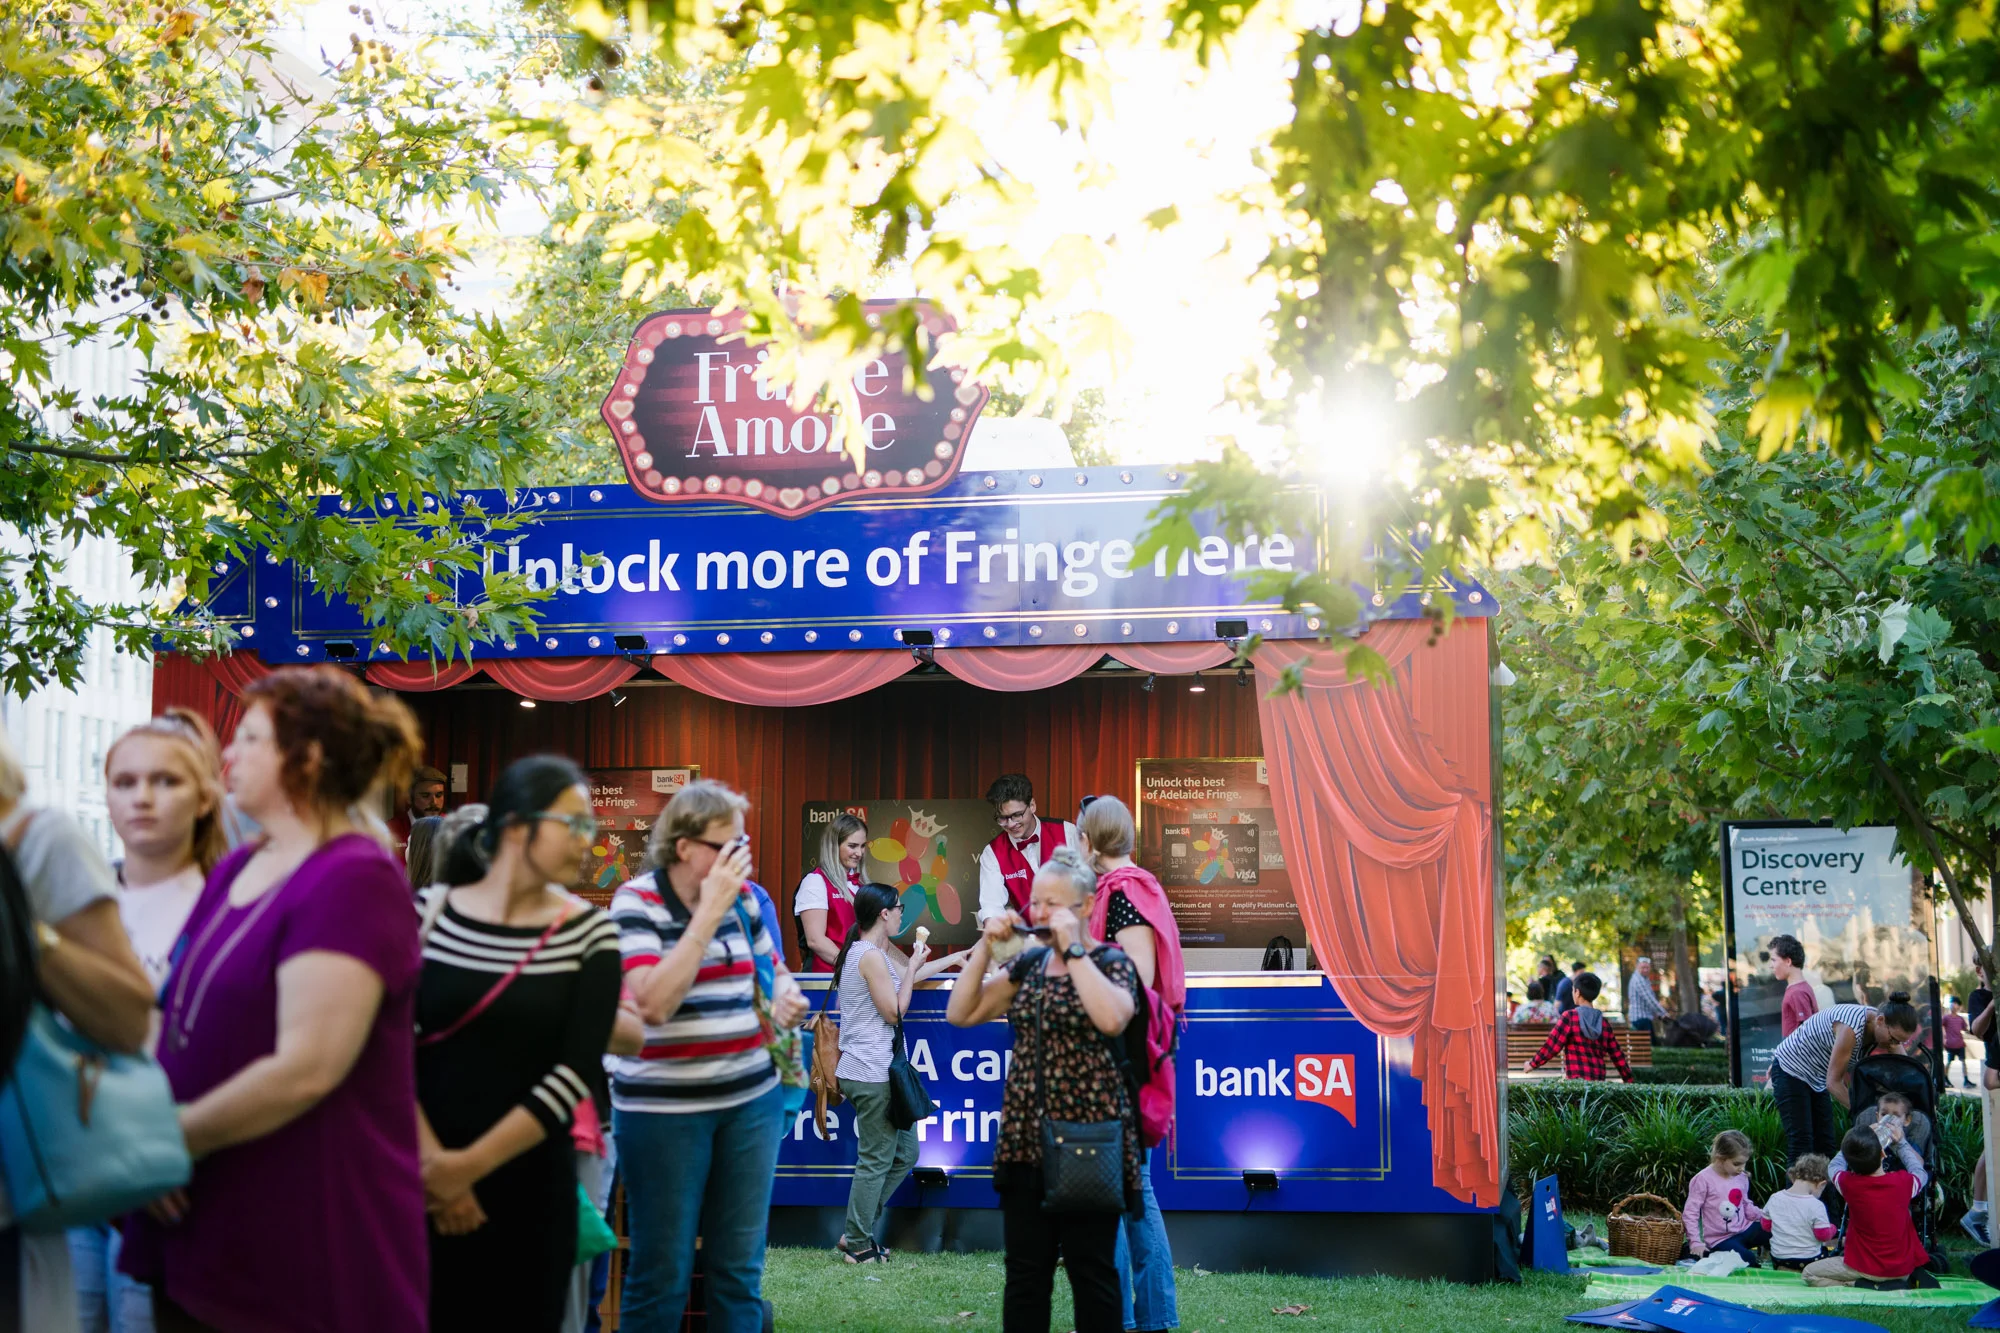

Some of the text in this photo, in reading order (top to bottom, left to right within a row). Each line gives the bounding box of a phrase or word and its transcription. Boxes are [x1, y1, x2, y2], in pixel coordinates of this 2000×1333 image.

[693, 350, 889, 404] Frie
[483, 539, 681, 595] Unlock
[696, 547, 850, 591] more
[866, 531, 931, 587] of
[945, 528, 1135, 598] Fringe
[1146, 777, 1226, 788] Unlock the best
[589, 785, 623, 795] he best
[1146, 789, 1242, 801] of Adelaide Fringe.
[605, 797, 638, 809] Fringe.
[1165, 827, 1191, 836] bankSA
[1234, 846, 1256, 854] vertigo
[1741, 847, 1865, 874] Discovery
[1235, 869, 1257, 880] VISA
[1742, 876, 1827, 896] Centre
[1232, 902, 1256, 910] Amplify
[1195, 1057, 1353, 1097] bankSA
[917, 1098, 1003, 1143] Frin
